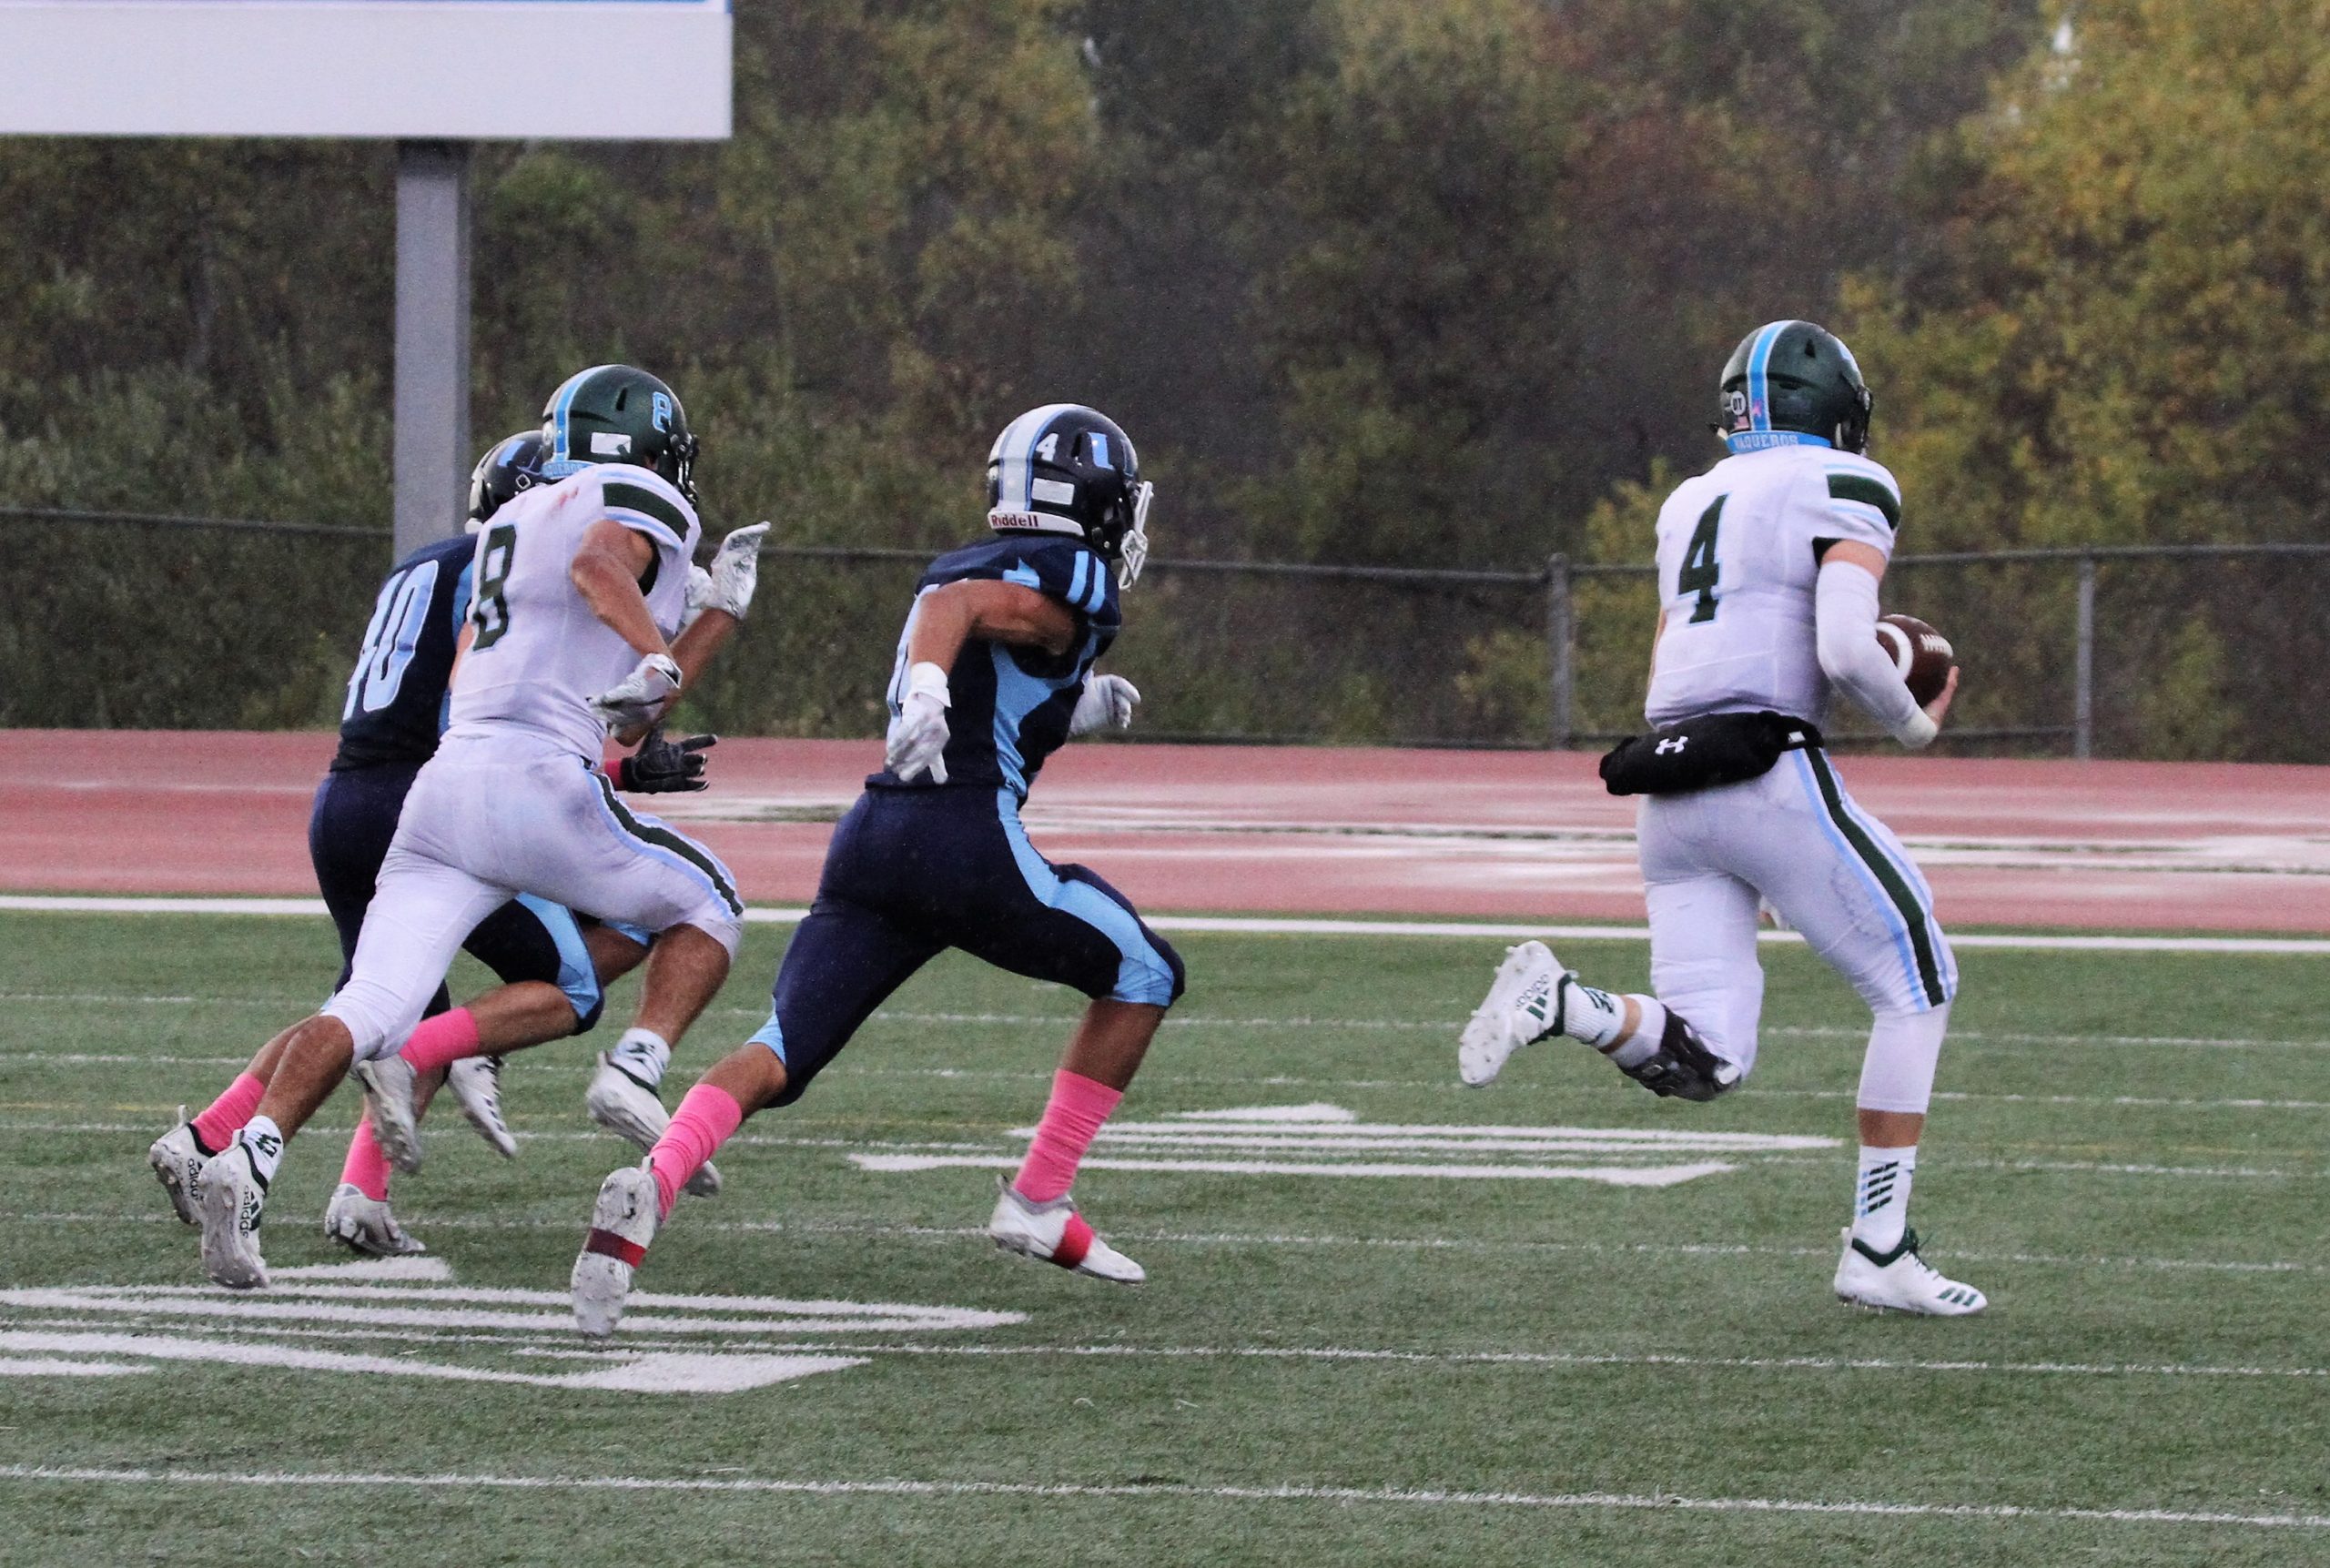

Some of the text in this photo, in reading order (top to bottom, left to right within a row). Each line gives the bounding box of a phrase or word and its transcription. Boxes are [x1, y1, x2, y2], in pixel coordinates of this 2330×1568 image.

[1035, 432, 1059, 462] 4
[991, 513, 1038, 527] Riddell
[1677, 491, 1731, 627] 4
[471, 523, 518, 653] 8
